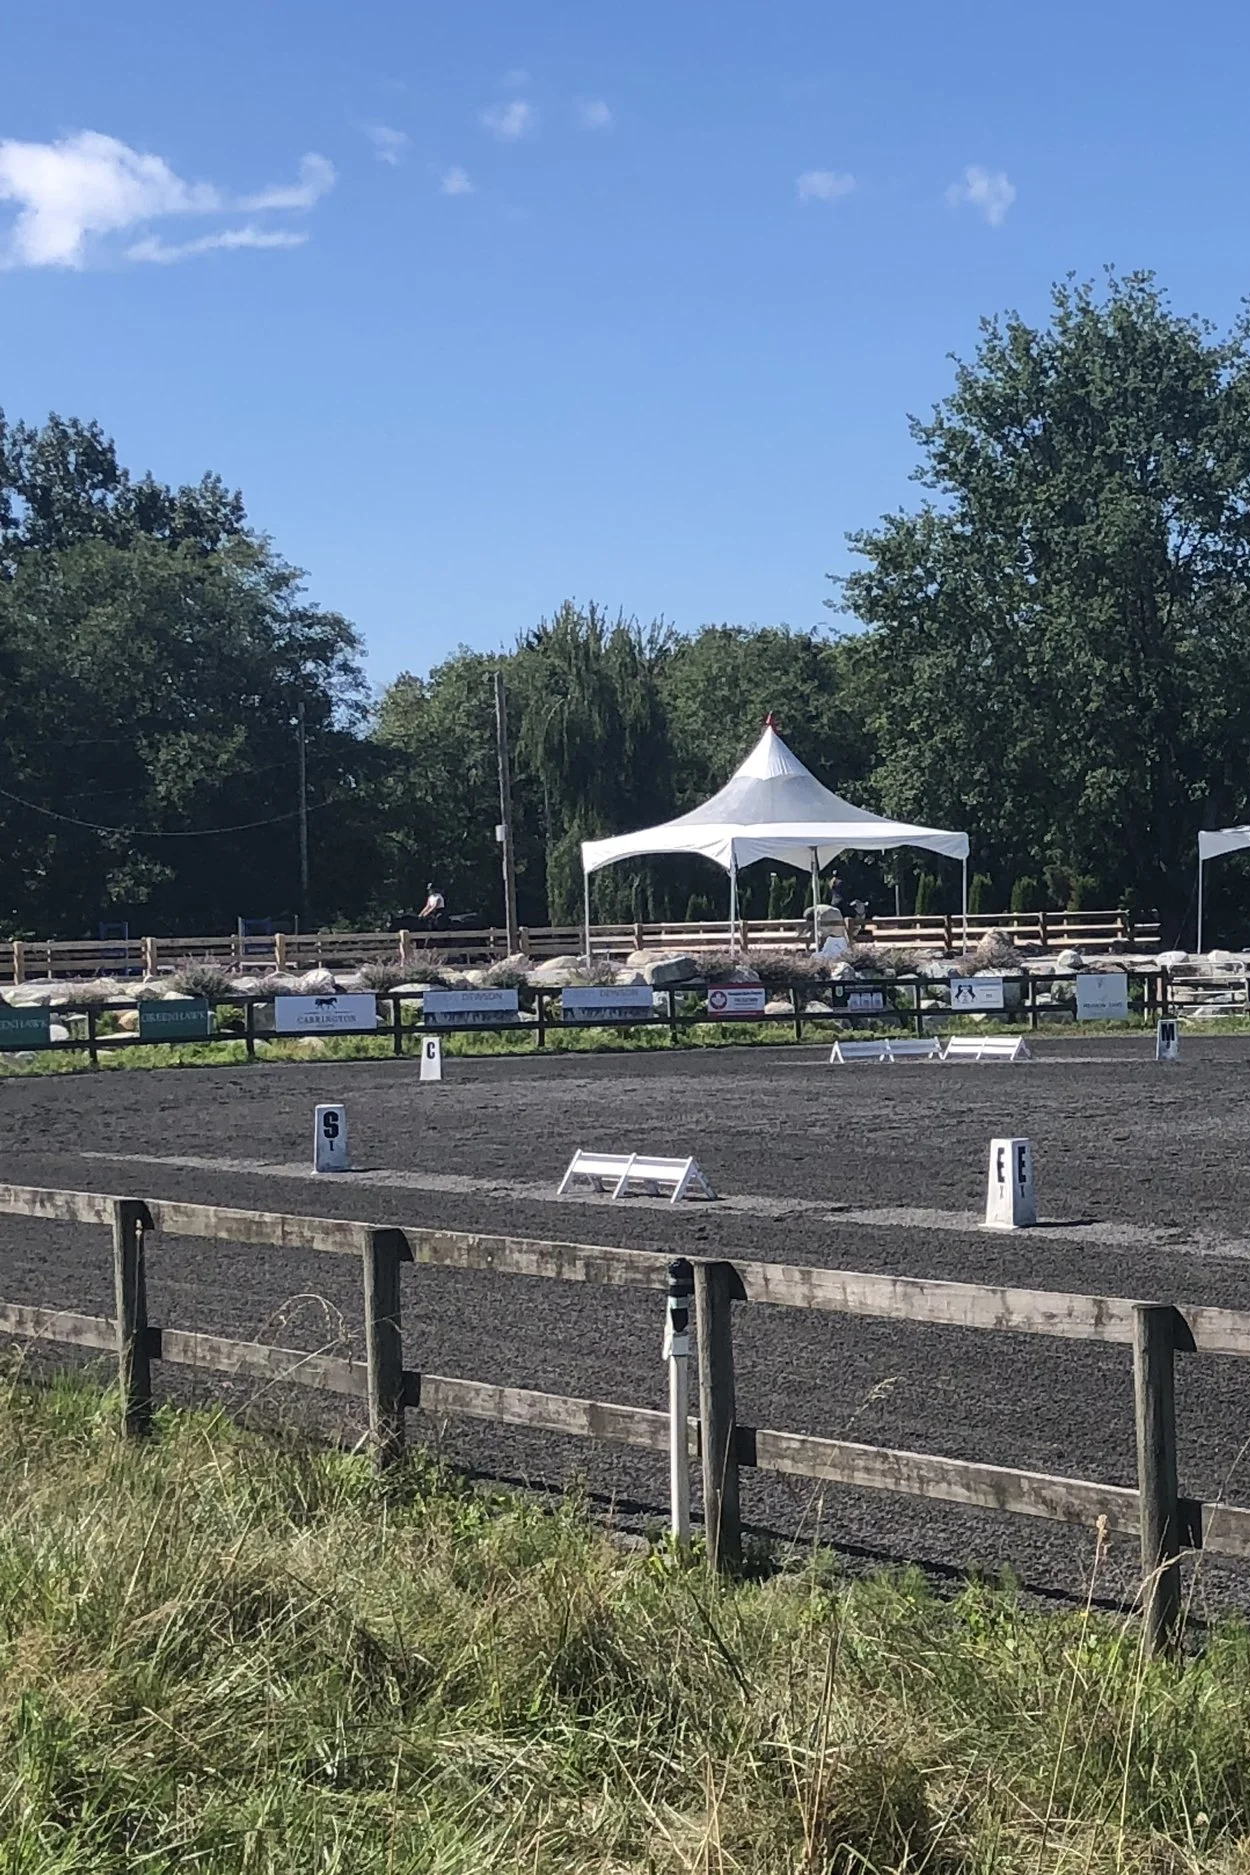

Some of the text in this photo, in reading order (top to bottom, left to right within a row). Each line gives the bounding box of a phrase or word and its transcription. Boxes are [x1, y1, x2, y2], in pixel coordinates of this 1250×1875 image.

[142, 1009, 207, 1023] GREENHAWK
[296, 1014, 357, 1025] CARRINGTON
[1161, 1023, 1176, 1041] M
[426, 1041, 436, 1060] C
[323, 1110, 340, 1139] S
[996, 1147, 1005, 1184] E
[1017, 1146, 1027, 1184] E
